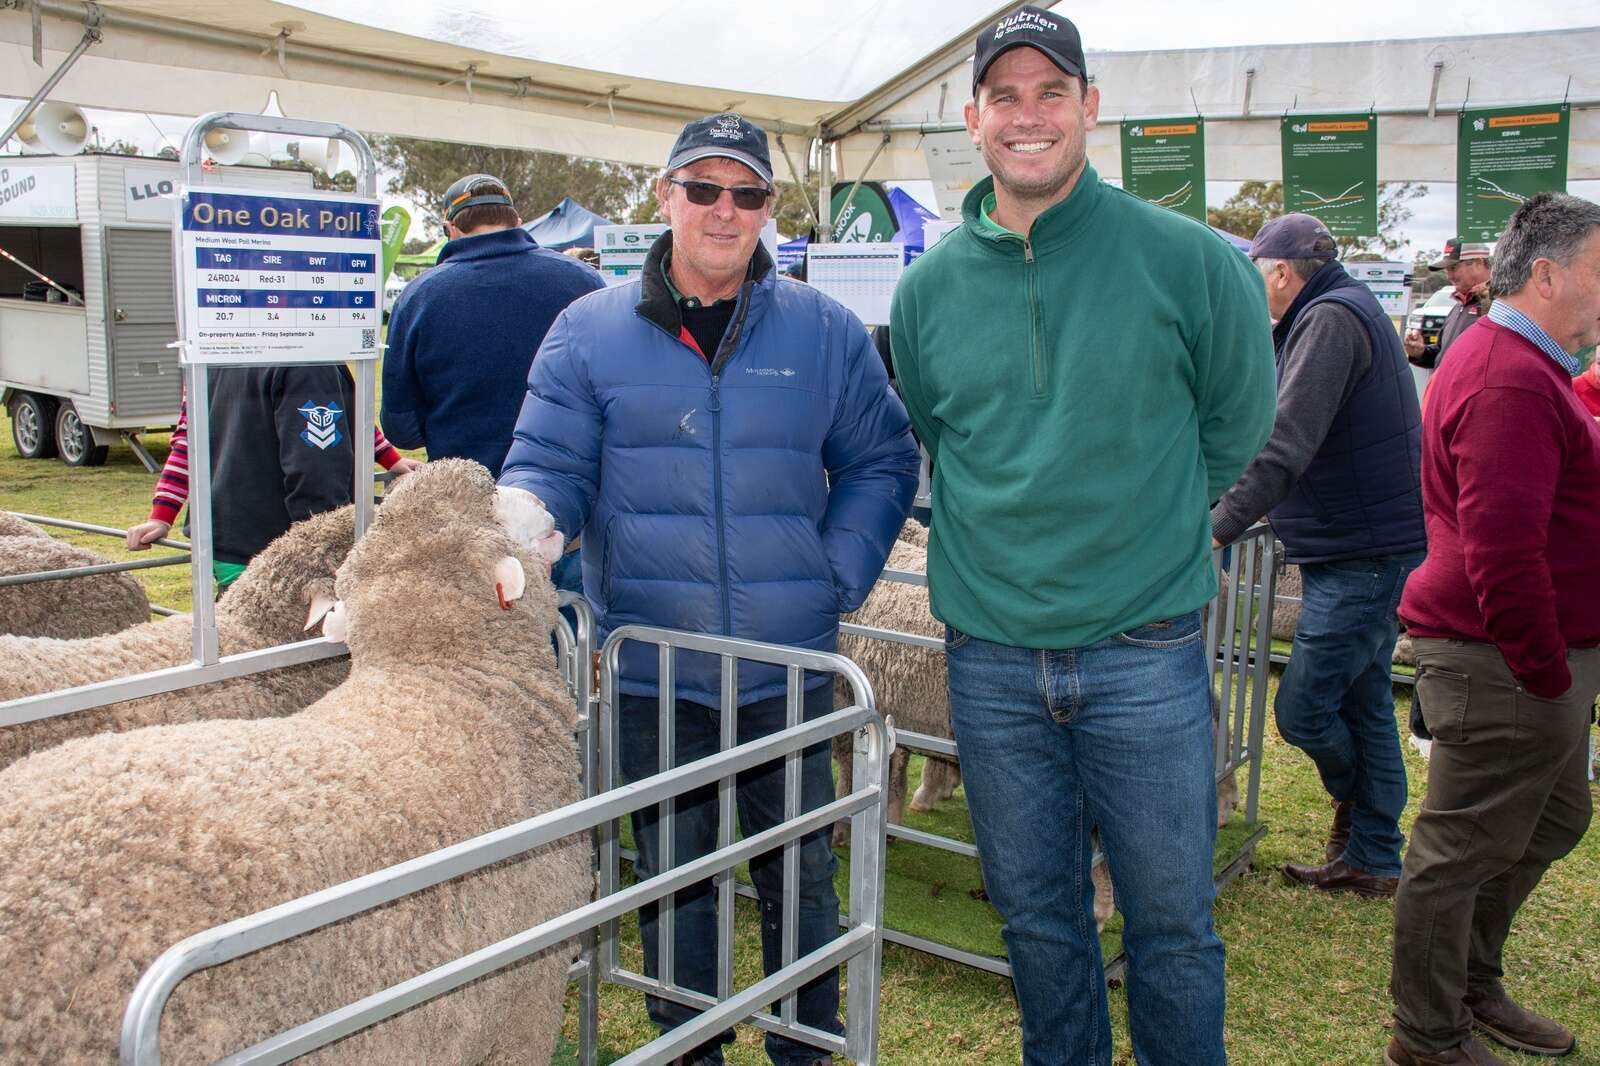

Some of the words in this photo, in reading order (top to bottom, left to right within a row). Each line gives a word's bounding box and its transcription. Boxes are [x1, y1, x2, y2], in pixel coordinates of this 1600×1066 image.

[996, 11, 1058, 32] Nutrien
[993, 31, 1004, 41] Ag
[1005, 22, 1044, 34] Solutions
[193, 202, 250, 226] One
[260, 207, 311, 229] Oak
[319, 210, 361, 232] Poll
[214, 253, 232, 263] TAG
[263, 255, 282, 264] SIRE
[309, 257, 326, 266] BWT
[351, 259, 367, 268] GFW
[259, 275, 286, 284] Red-31
[311, 276, 325, 284] 105
[353, 277, 364, 285] 6.0
[206, 294, 242, 304] MICRON
[267, 295, 279, 304] SD
[312, 296, 324, 304] CV
[354, 296, 364, 305] CF
[216, 312, 234, 321] 20.7
[267, 312, 280, 321] 3.4
[311, 312, 326, 321] 16.6
[352, 312, 366, 320] 99.4
